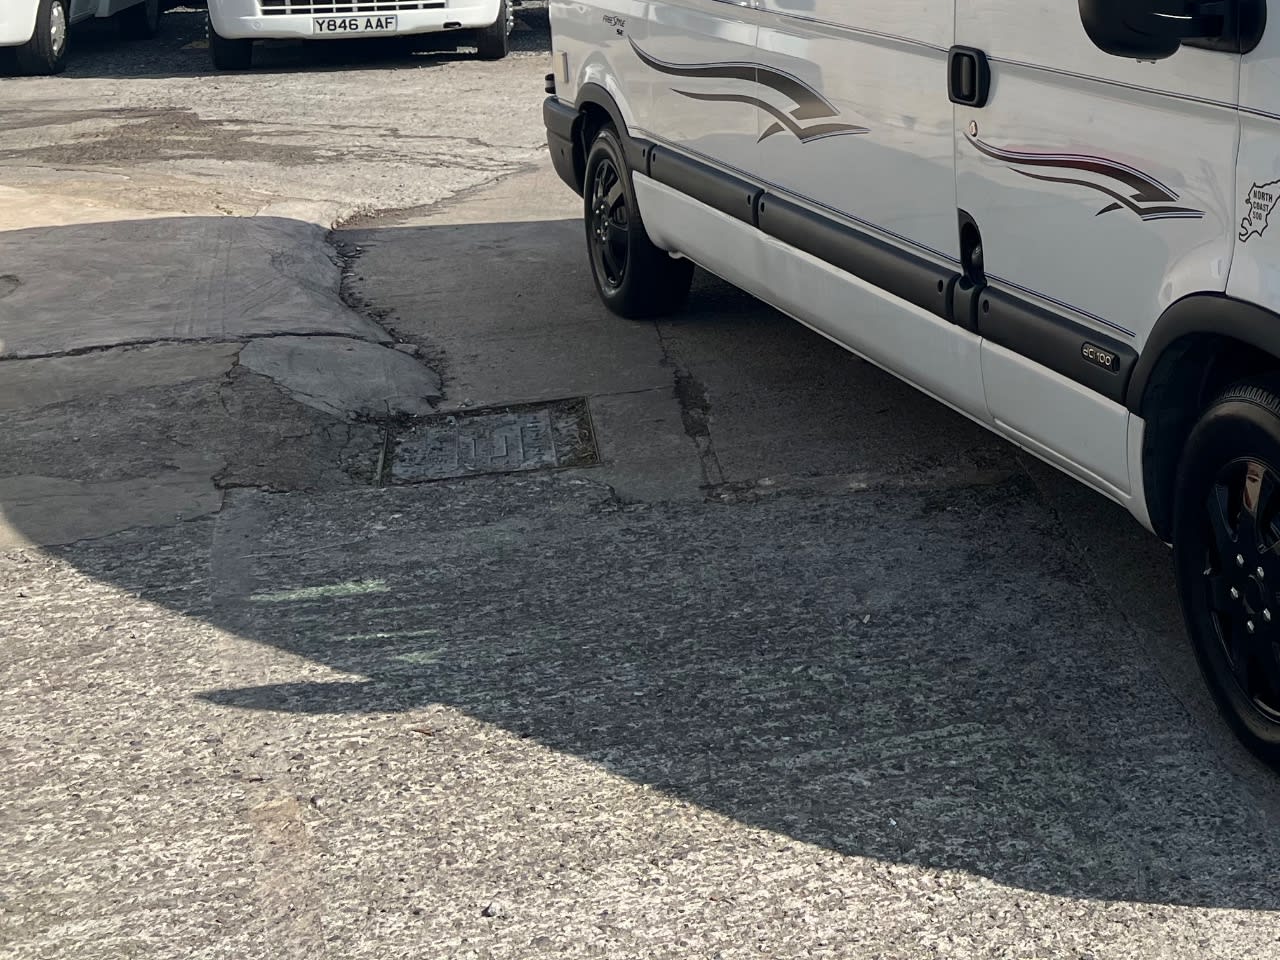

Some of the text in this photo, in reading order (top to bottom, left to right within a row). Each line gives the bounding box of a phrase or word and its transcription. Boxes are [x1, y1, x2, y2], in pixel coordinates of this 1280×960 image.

[315, 16, 395, 32] Y846 AAF
[1253, 189, 1273, 203] NORTH
[1252, 201, 1269, 212] COAST
[1096, 352, 1112, 366] 100
